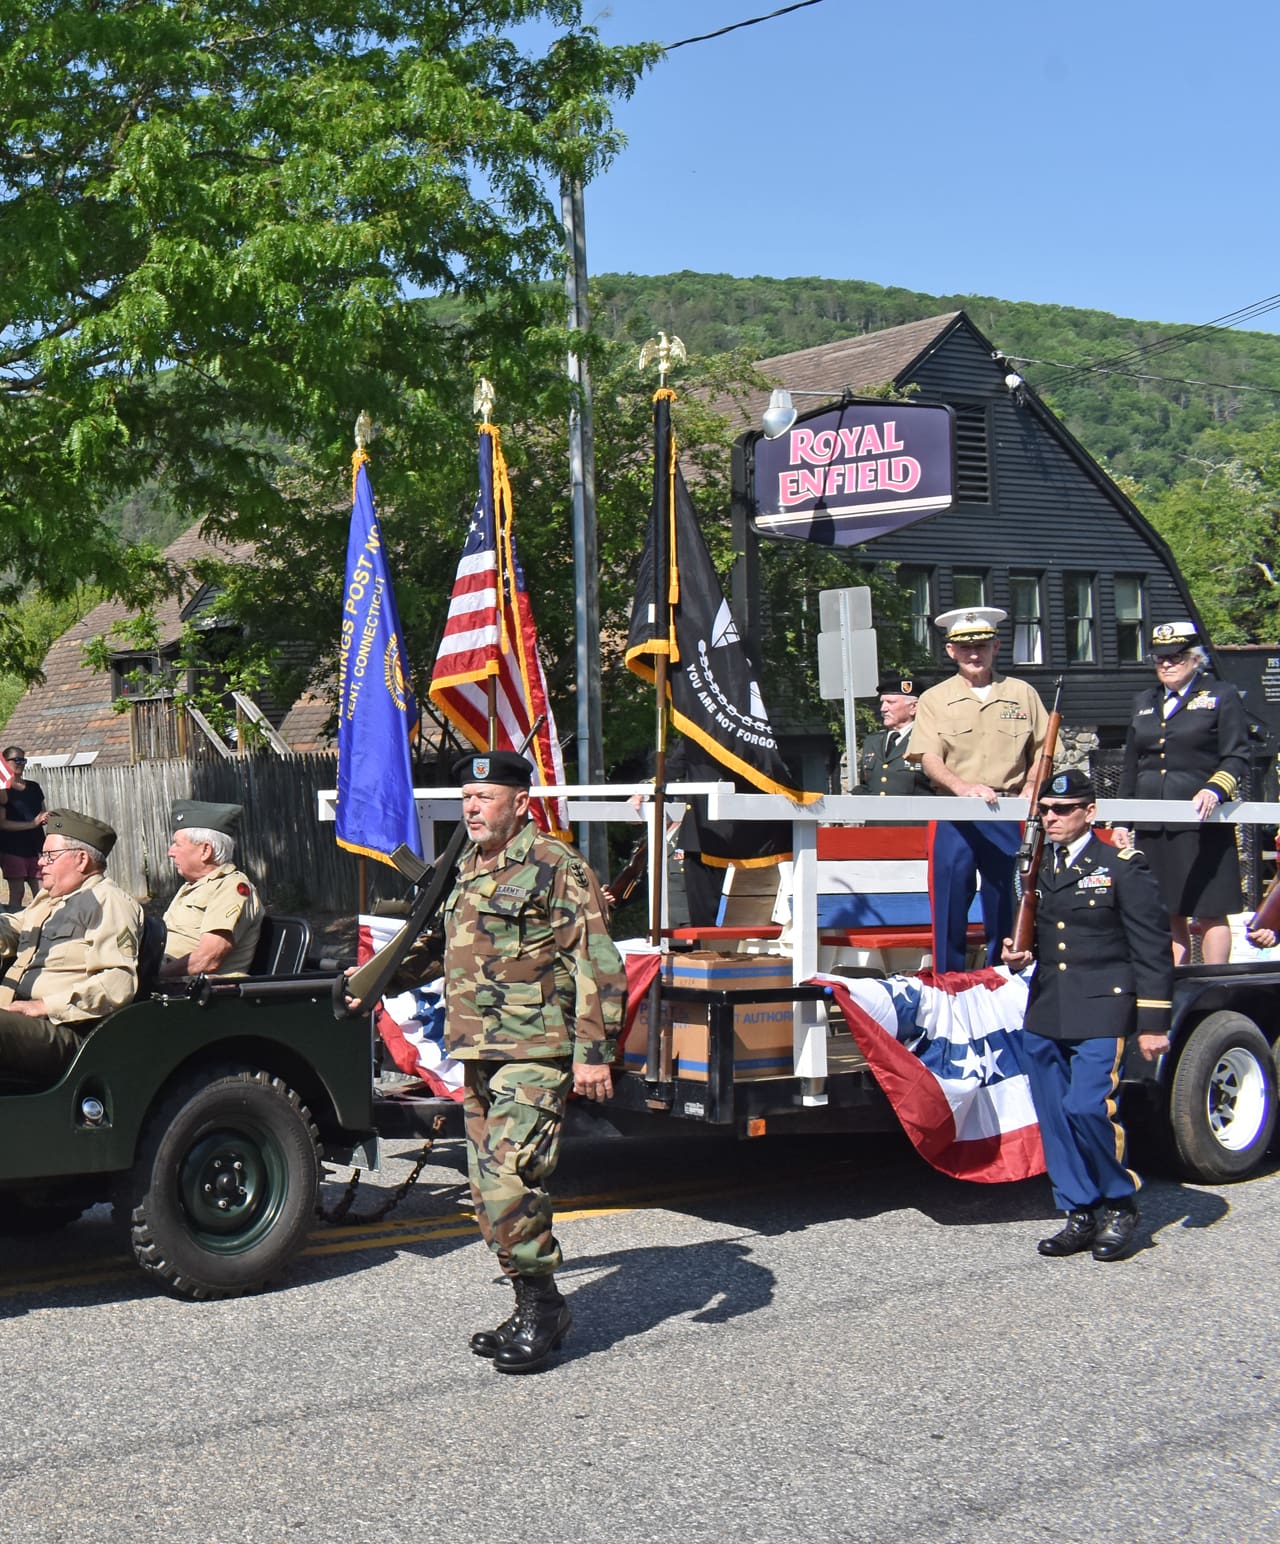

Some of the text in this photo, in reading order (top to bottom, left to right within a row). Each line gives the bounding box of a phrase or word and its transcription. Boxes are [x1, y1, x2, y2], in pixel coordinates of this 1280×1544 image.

[789, 421, 904, 466] ROYAL
[778, 456, 921, 507] ENFIELD
[345, 554, 373, 615] POST
[346, 576, 386, 721] KENT, CONNECTICUT
[686, 664, 778, 750] YOU ARE NOT FORGO
[743, 1010, 793, 1024] AUTHOR
